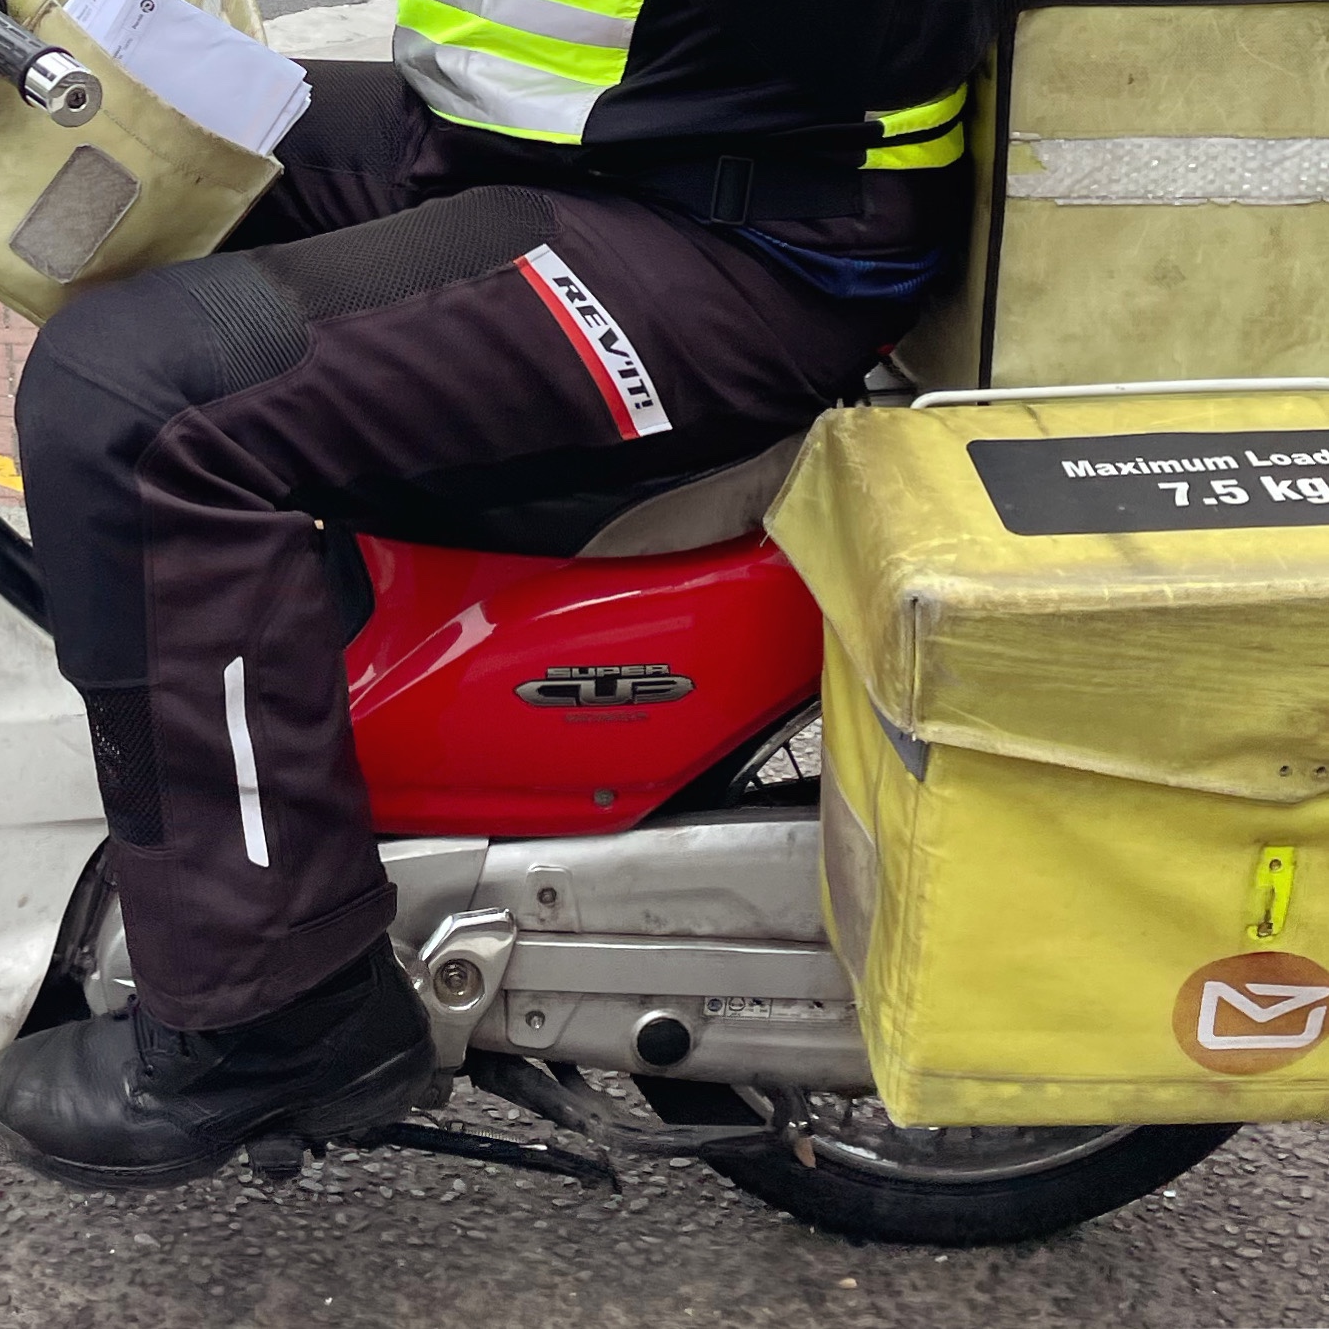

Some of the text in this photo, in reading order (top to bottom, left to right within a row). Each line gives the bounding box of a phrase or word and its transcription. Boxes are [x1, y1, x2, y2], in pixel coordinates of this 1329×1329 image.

[1061, 448, 1329, 479] Maximum Load
[1157, 475, 1329, 508] 7.5 kg
[546, 664, 670, 679] SUPER
[514, 675, 696, 707] CUP
